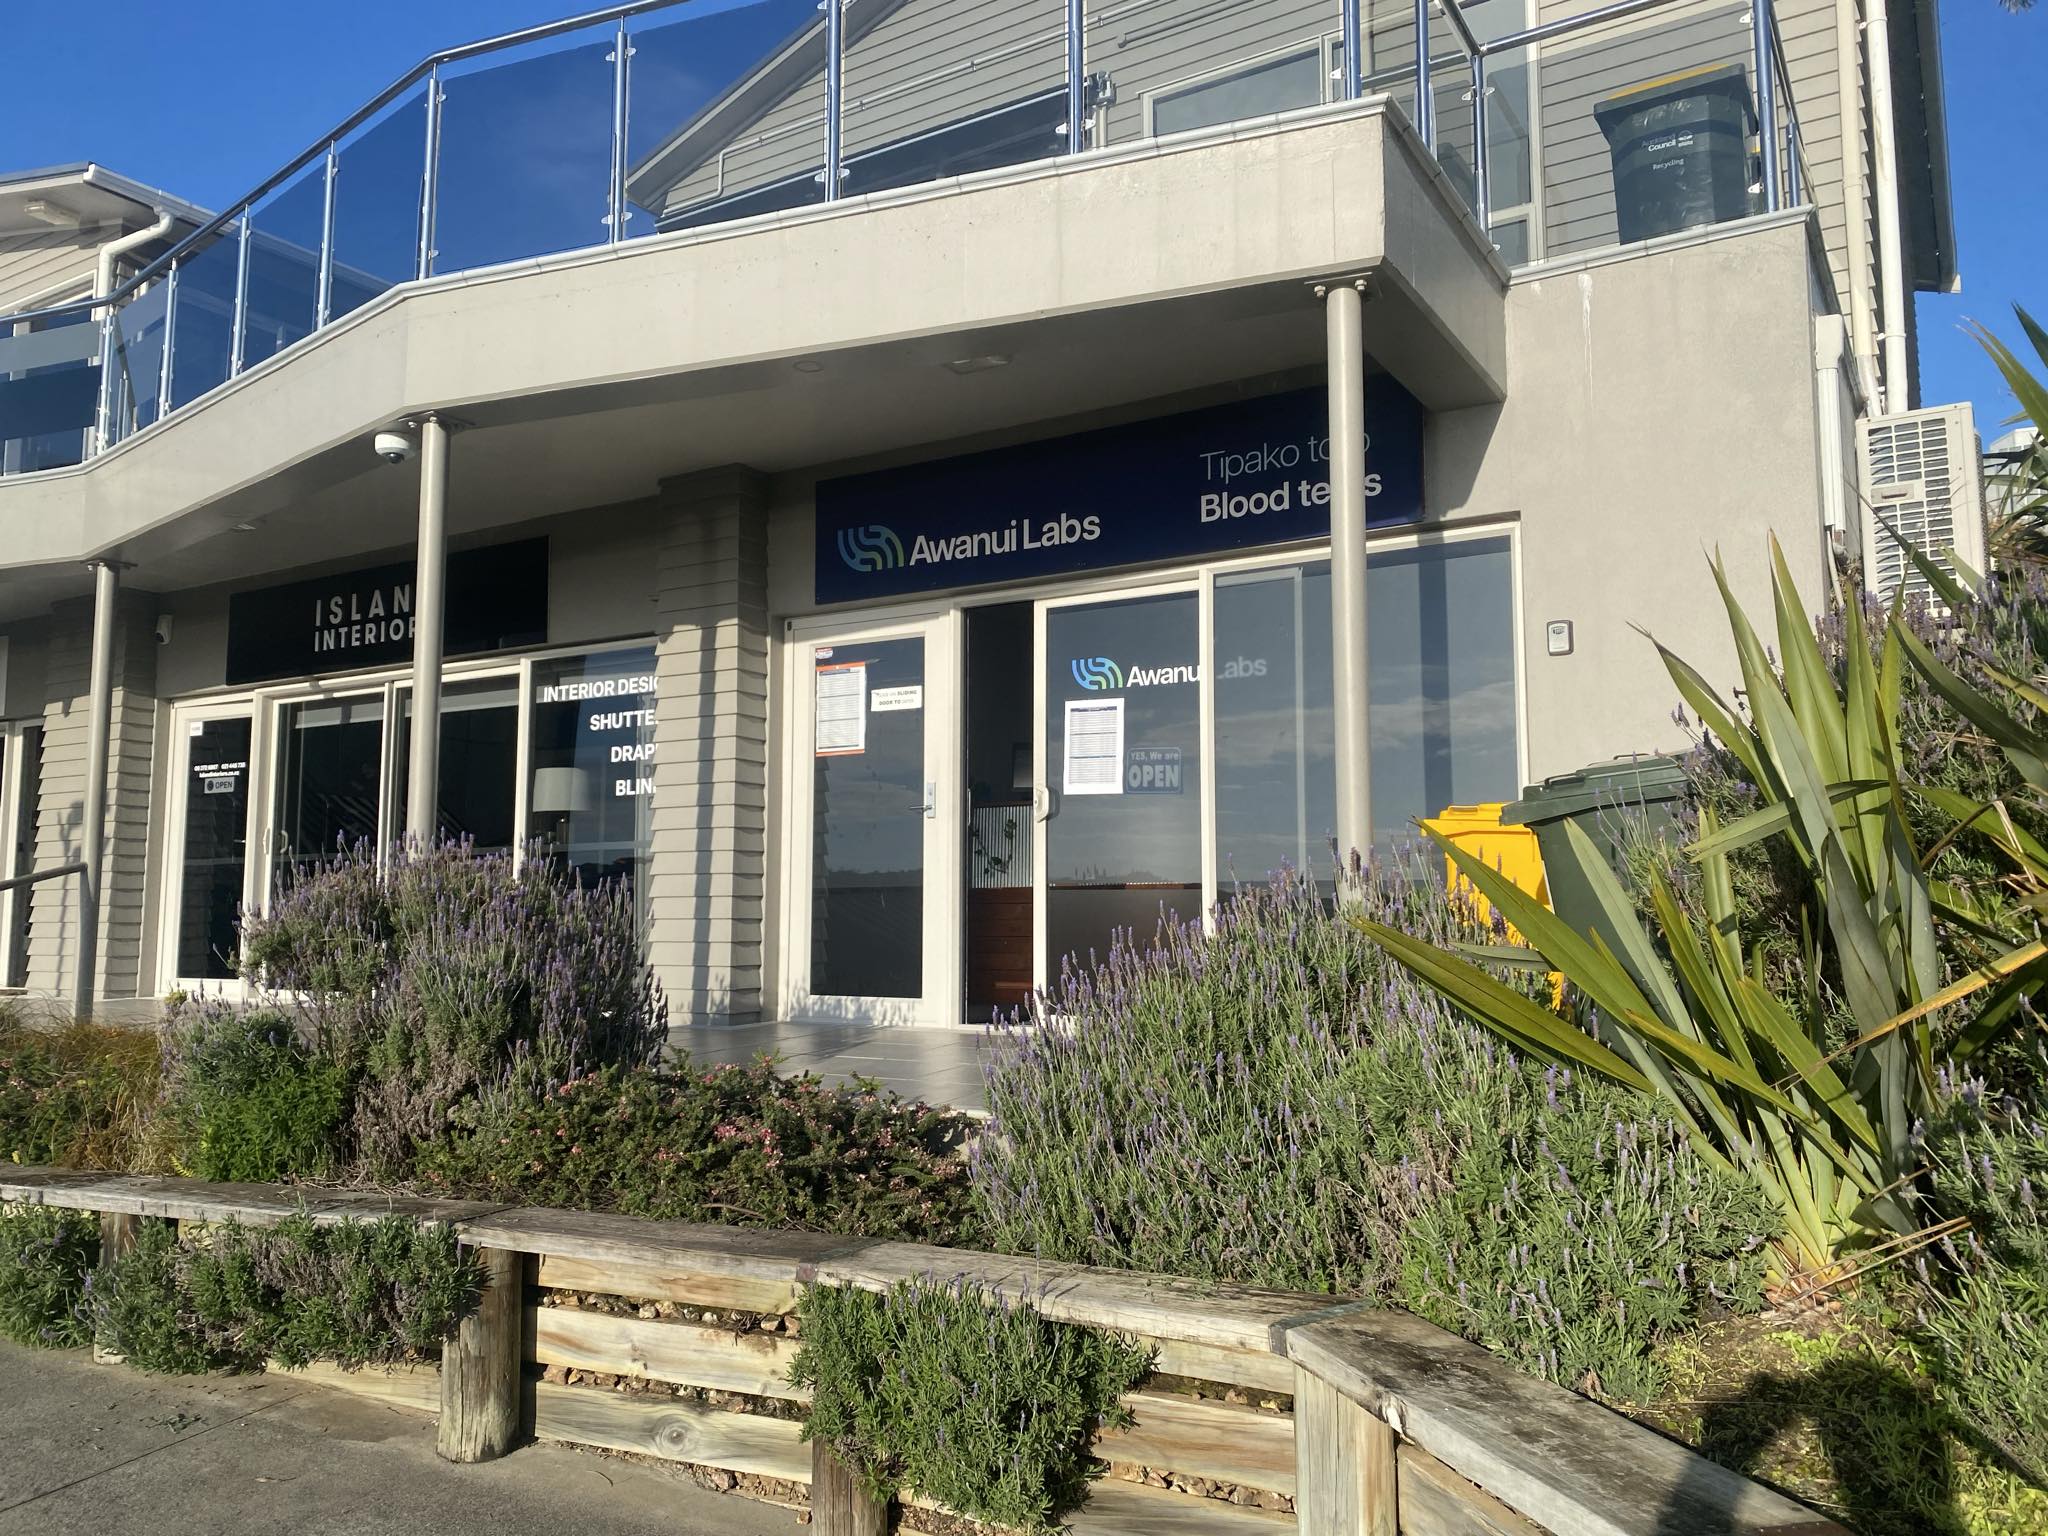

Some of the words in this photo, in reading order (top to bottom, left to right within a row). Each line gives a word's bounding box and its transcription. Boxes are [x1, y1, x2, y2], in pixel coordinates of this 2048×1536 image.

[1648, 139, 1676, 151] Council
[1653, 158, 1684, 170] Recycling
[1307, 432, 1370, 462] to
[1200, 481, 1290, 523] Blood
[1298, 473, 1382, 507] tes
[909, 519, 1017, 566] Awanui
[1023, 512, 1101, 549] Labs
[315, 584, 410, 627] ISLAN
[314, 616, 416, 652] INTERIOR
[1126, 665, 1200, 688] Awanu
[1216, 656, 1268, 680] abs
[543, 680, 615, 703] INTERIOR
[589, 709, 659, 731] SHUTTE
[611, 743, 659, 763] DRAP
[1130, 751, 1149, 762] YES,
[1150, 751, 1163, 761] We
[1164, 752, 1179, 761] are
[215, 780, 233, 789] OPEN
[615, 777, 657, 796] BLIN
[1128, 763, 1179, 788] OPEN
